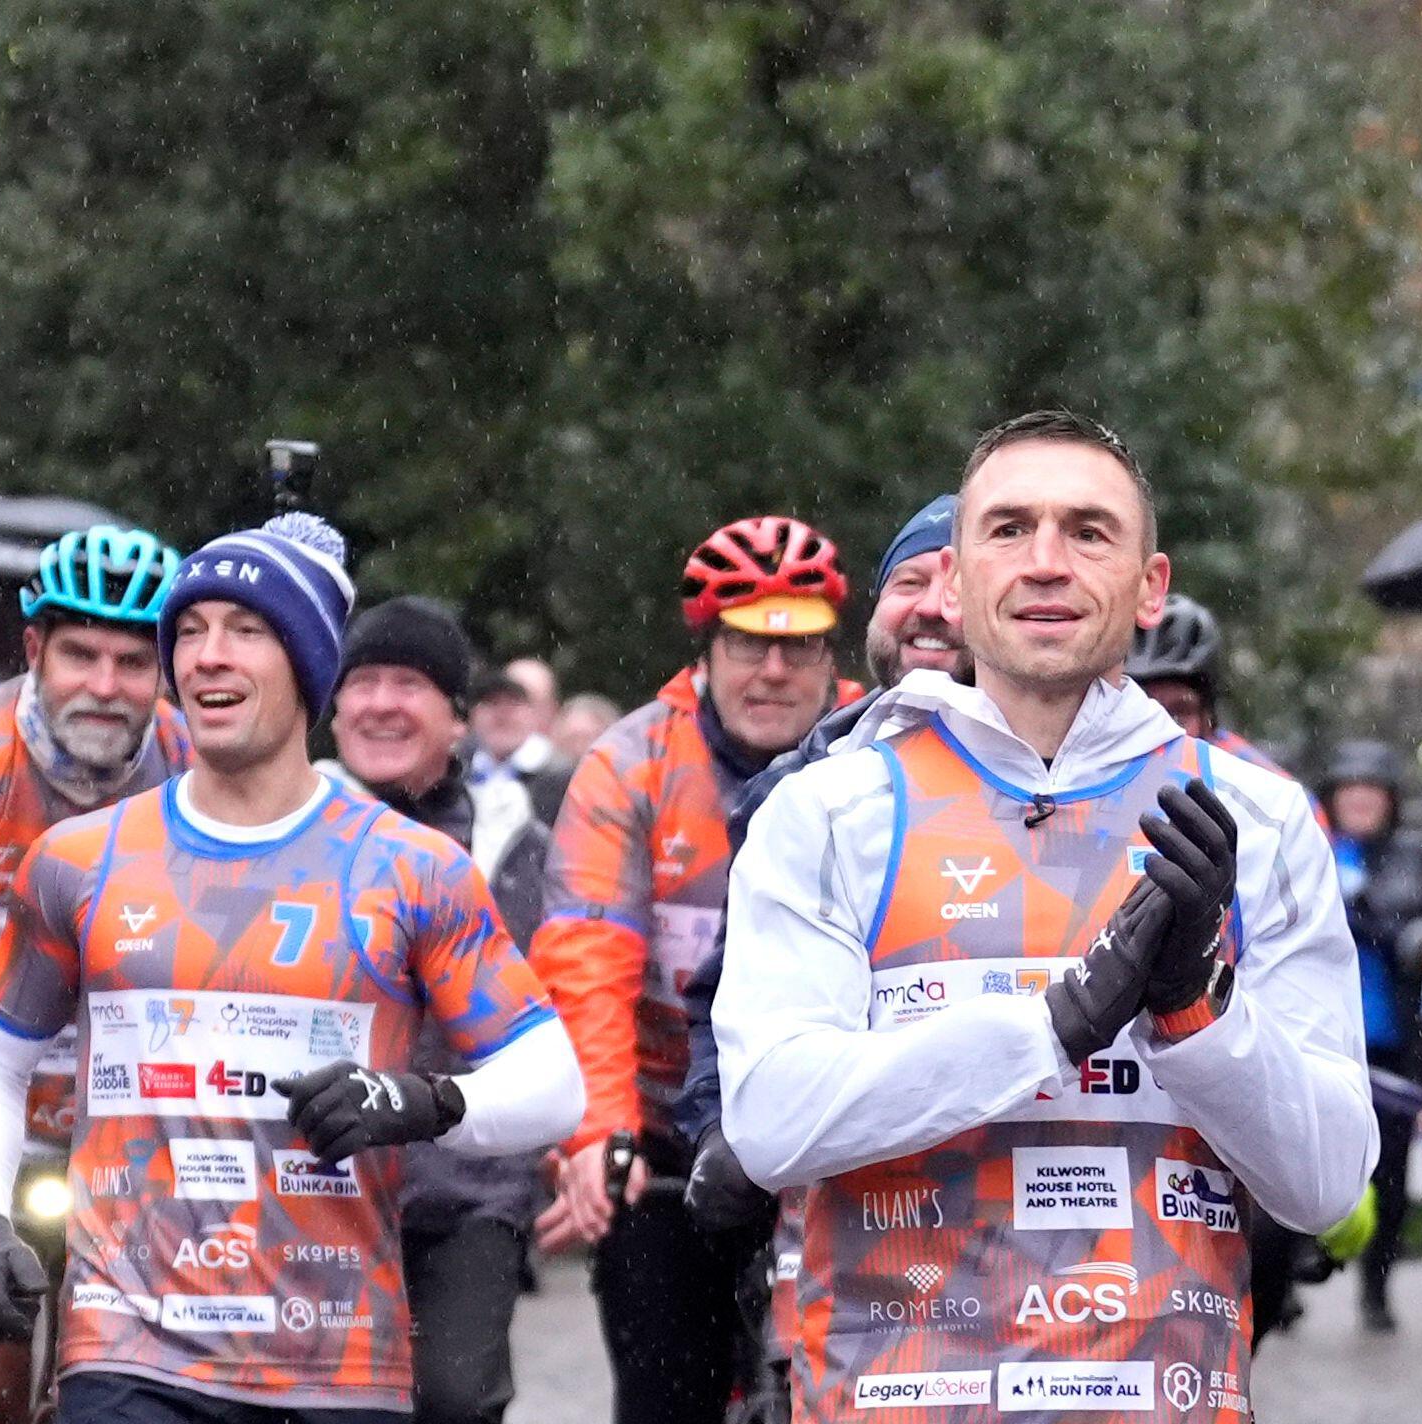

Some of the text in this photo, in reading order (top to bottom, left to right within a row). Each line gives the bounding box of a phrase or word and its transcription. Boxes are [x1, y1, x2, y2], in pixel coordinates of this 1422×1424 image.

[171, 561, 261, 587] XEN
[940, 902, 999, 920] OXEN
[271, 901, 317, 966] 7
[114, 938, 153, 952] OXEN
[877, 977, 946, 1004] mnda
[246, 1015, 298, 1027] Hospitals
[249, 1027, 291, 1039] Charity
[1037, 1166, 1105, 1178] KILWORTH
[1026, 1182, 1117, 1193] HOUSE HOTEL
[863, 1188, 944, 1231] EUAN'S
[1026, 1197, 1119, 1208] AND THEATRE
[172, 1238, 251, 1269] ACS
[283, 1245, 361, 1263] SKOPES
[870, 1297, 981, 1321] ROMERO
[1015, 1283, 1127, 1324] ACS
[1171, 1290, 1240, 1320] SKOPES
[246, 1312, 265, 1321] ALL
[1050, 1385, 1141, 1396] RUN FOR ALL
